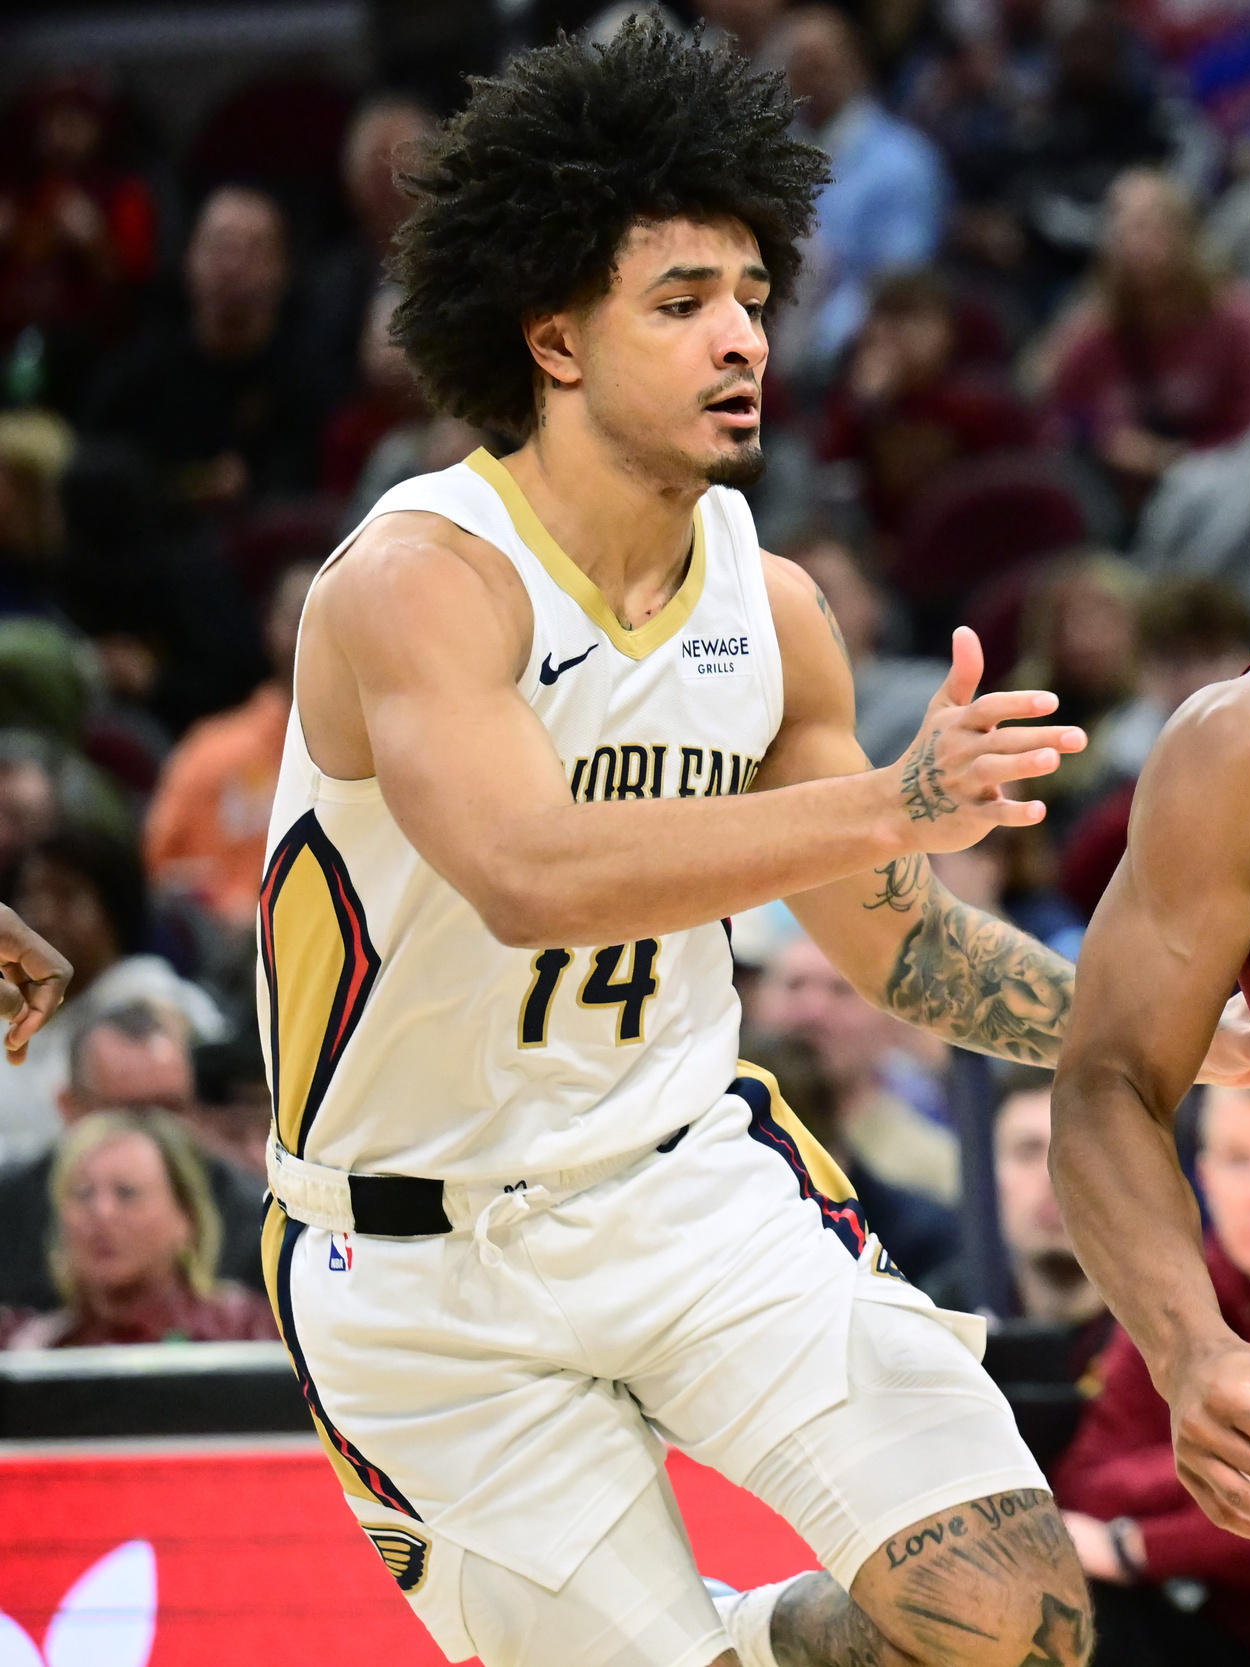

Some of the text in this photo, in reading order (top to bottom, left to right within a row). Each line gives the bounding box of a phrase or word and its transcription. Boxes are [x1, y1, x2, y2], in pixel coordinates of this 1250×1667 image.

[682, 637, 749, 658] NEWAGE
[697, 662, 735, 674] GRILLS
[584, 742, 761, 804] ORLEAN
[517, 937, 662, 1050] 14
[886, 1515, 969, 1571] Love
